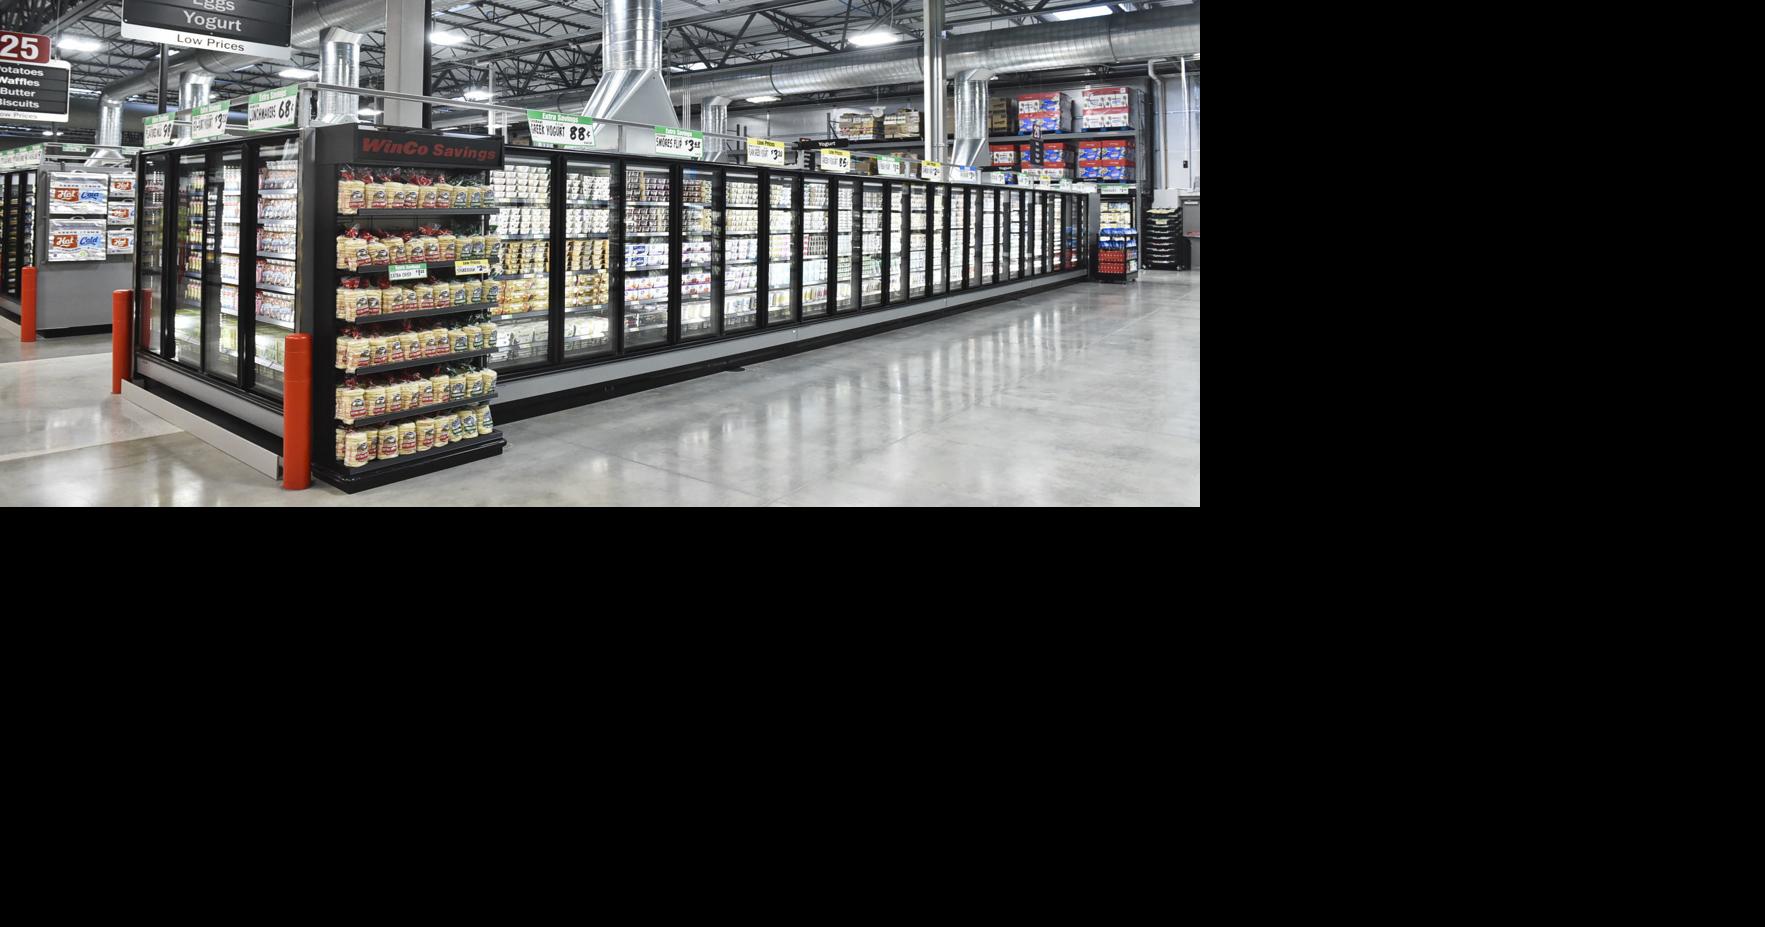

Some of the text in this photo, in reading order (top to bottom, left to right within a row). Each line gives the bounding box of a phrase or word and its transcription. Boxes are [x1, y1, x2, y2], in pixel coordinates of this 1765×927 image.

[184, 10, 242, 32] Yogurt
[0, 34, 39, 60] 25
[177, 33, 245, 52] Low Prices
[0, 66, 44, 77] otatoes
[0, 87, 36, 97] Butter
[542, 112, 557, 120] Extra
[362, 137, 497, 161] WinCo Savings
[57, 189, 76, 200] Hot
[56, 236, 99, 247] Hot Cold
